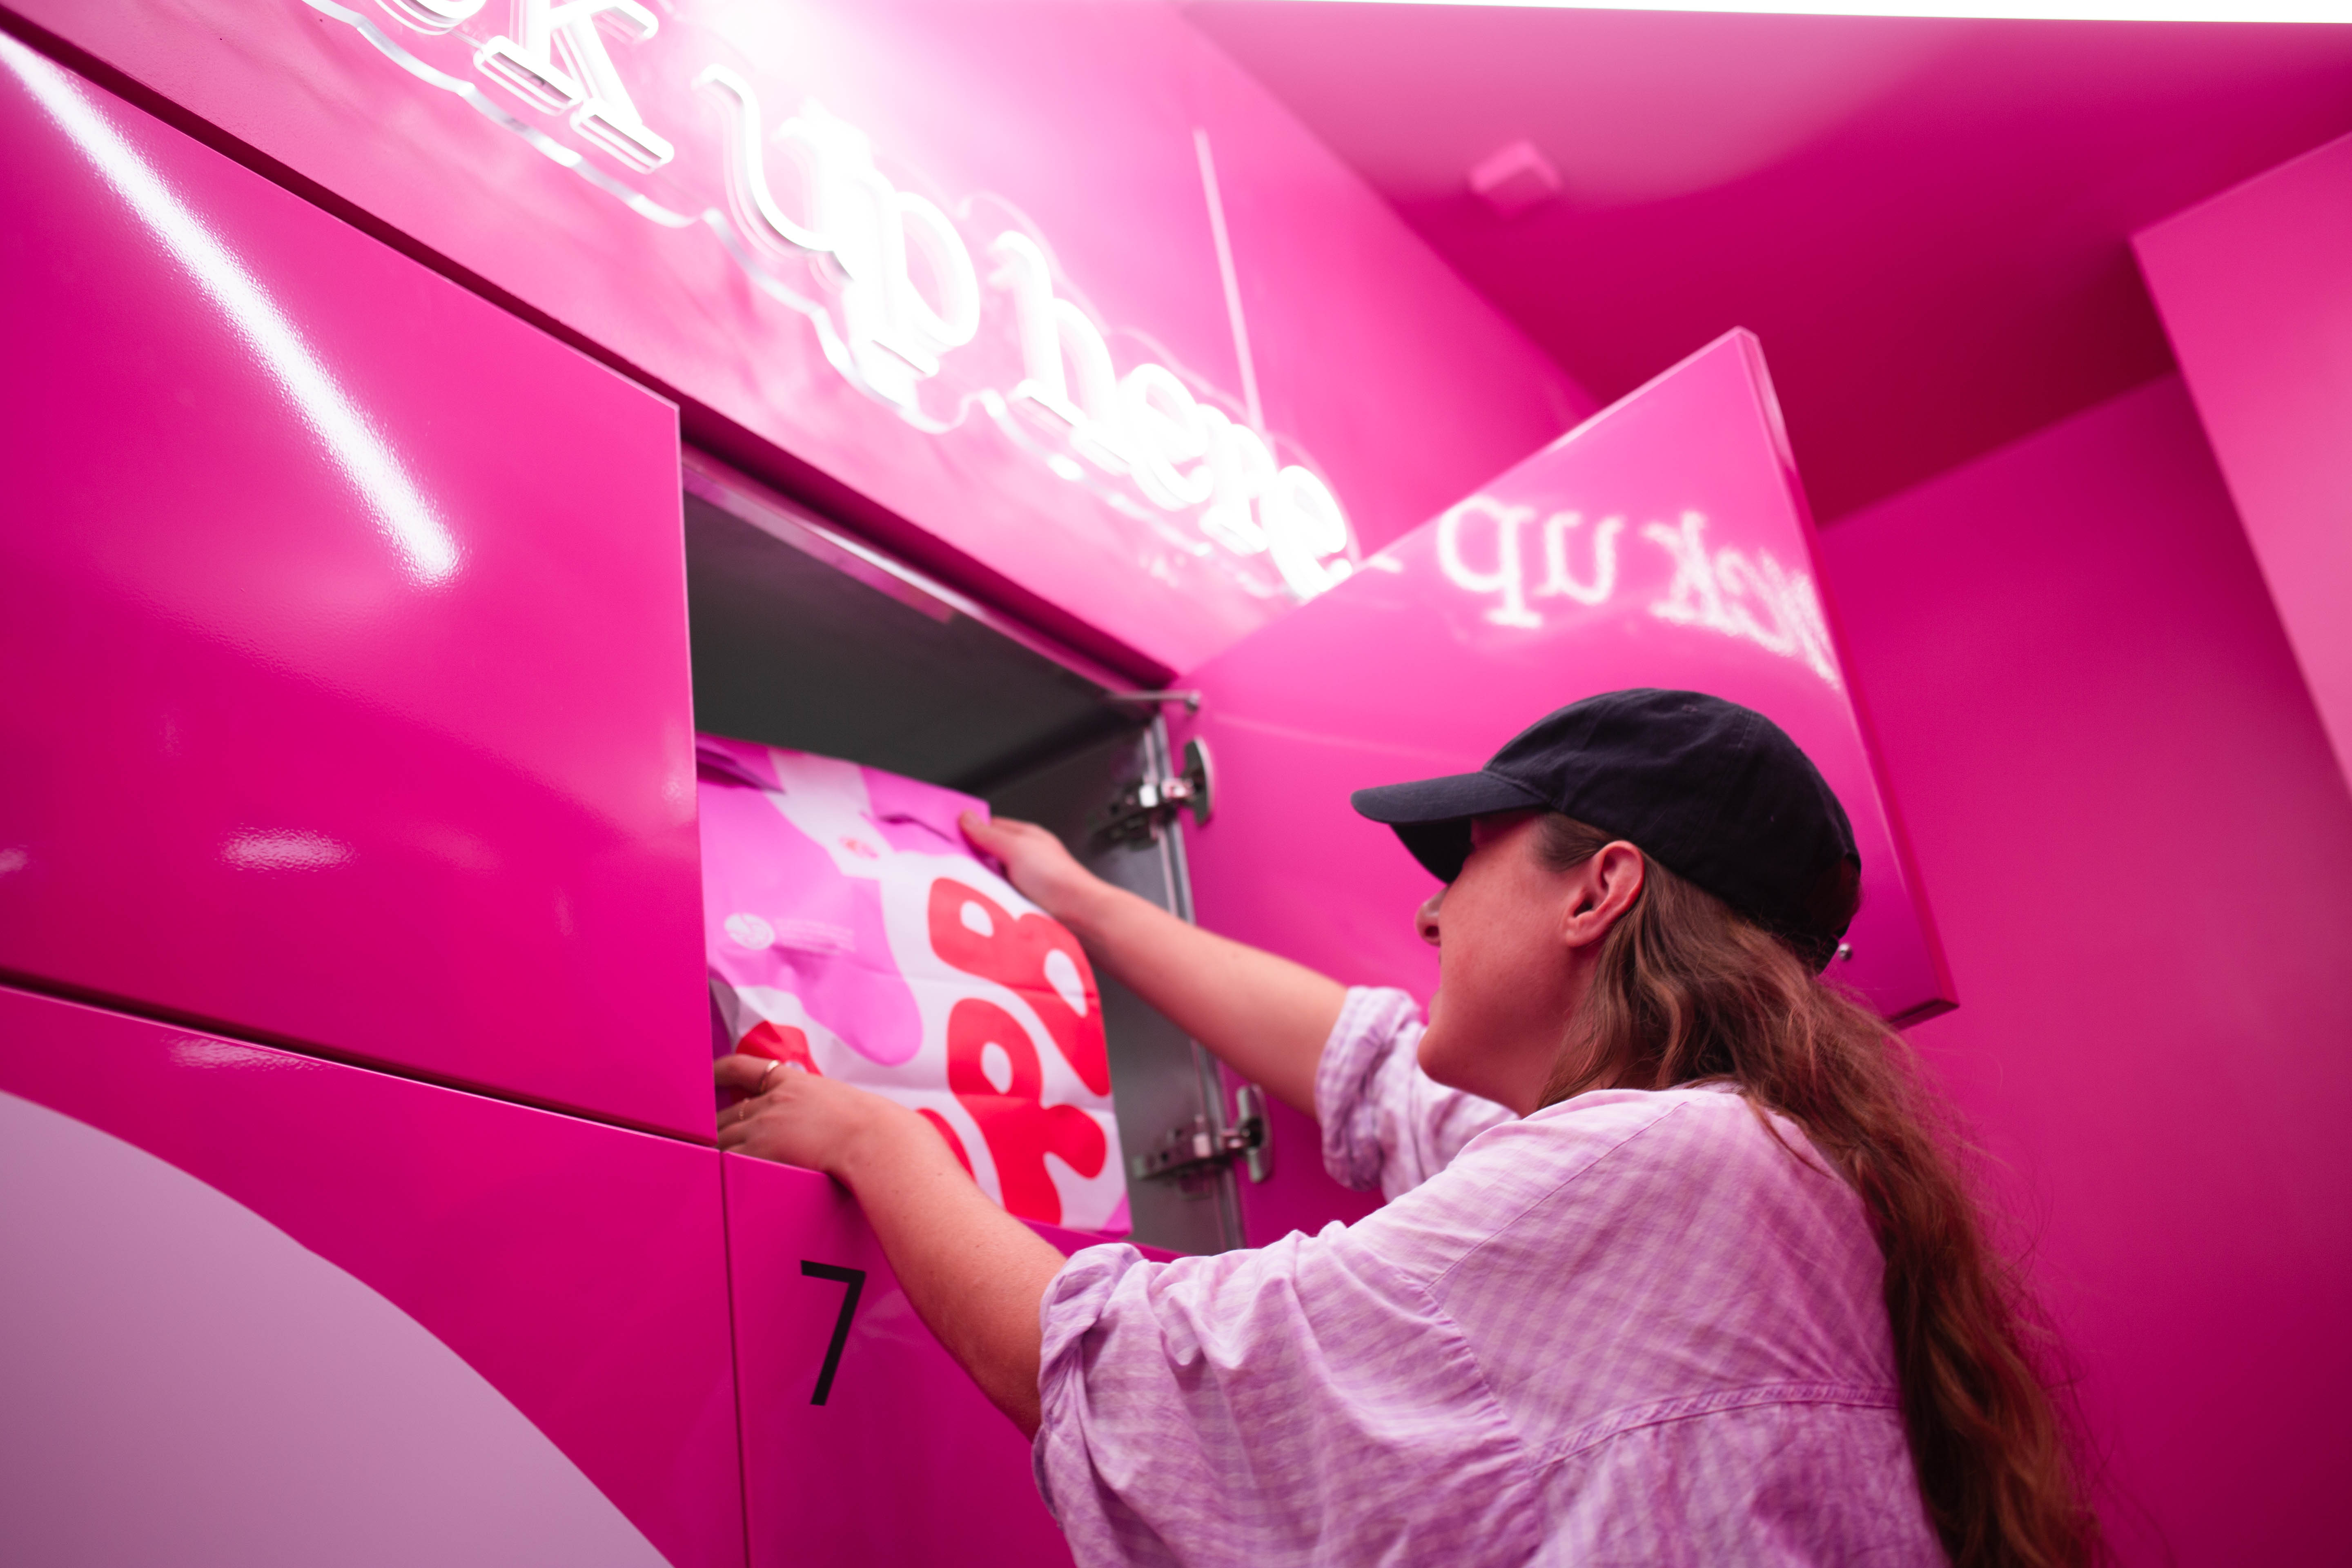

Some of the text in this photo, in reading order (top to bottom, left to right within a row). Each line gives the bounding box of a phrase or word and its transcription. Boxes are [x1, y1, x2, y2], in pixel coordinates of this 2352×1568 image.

[692, 63, 980, 396] up
[991, 229, 1352, 599] here
[800, 1260, 866, 1406] 7
